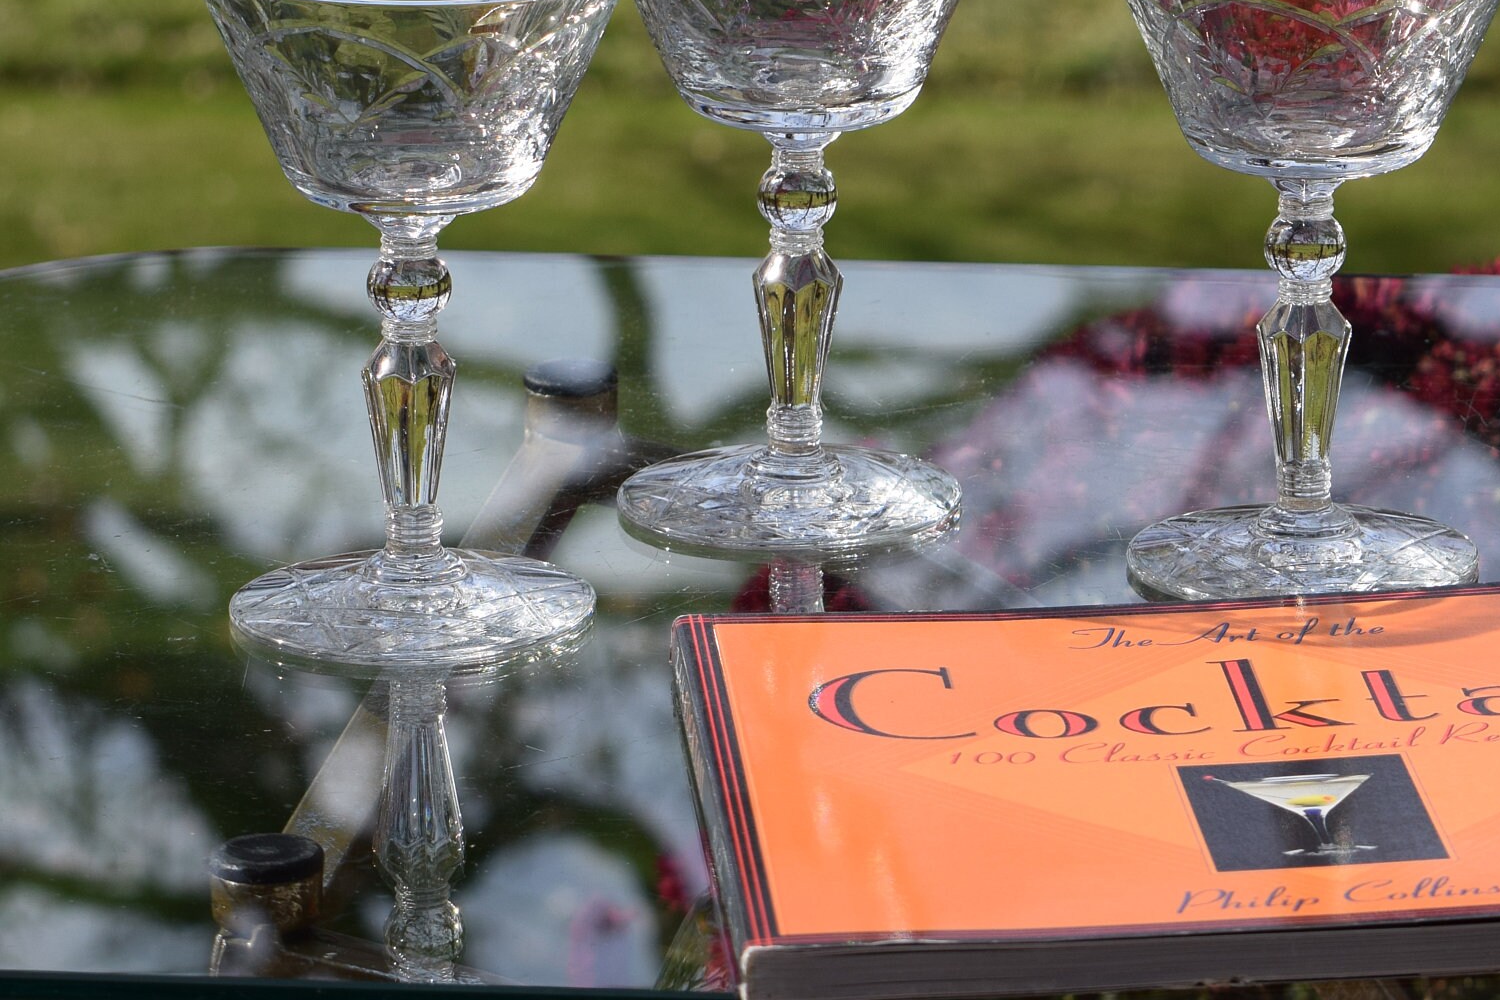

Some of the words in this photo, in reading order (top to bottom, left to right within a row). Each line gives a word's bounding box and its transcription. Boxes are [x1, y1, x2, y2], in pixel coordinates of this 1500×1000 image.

[1069, 627, 1153, 649] The
[1157, 622, 1261, 645] Art
[1277, 617, 1319, 645] of
[1330, 617, 1385, 637] the
[951, 751, 1036, 765] 100
[1060, 742, 1215, 764] Classic
[1238, 726, 1426, 758] Cocktail
[1176, 886, 1320, 914] Philip
